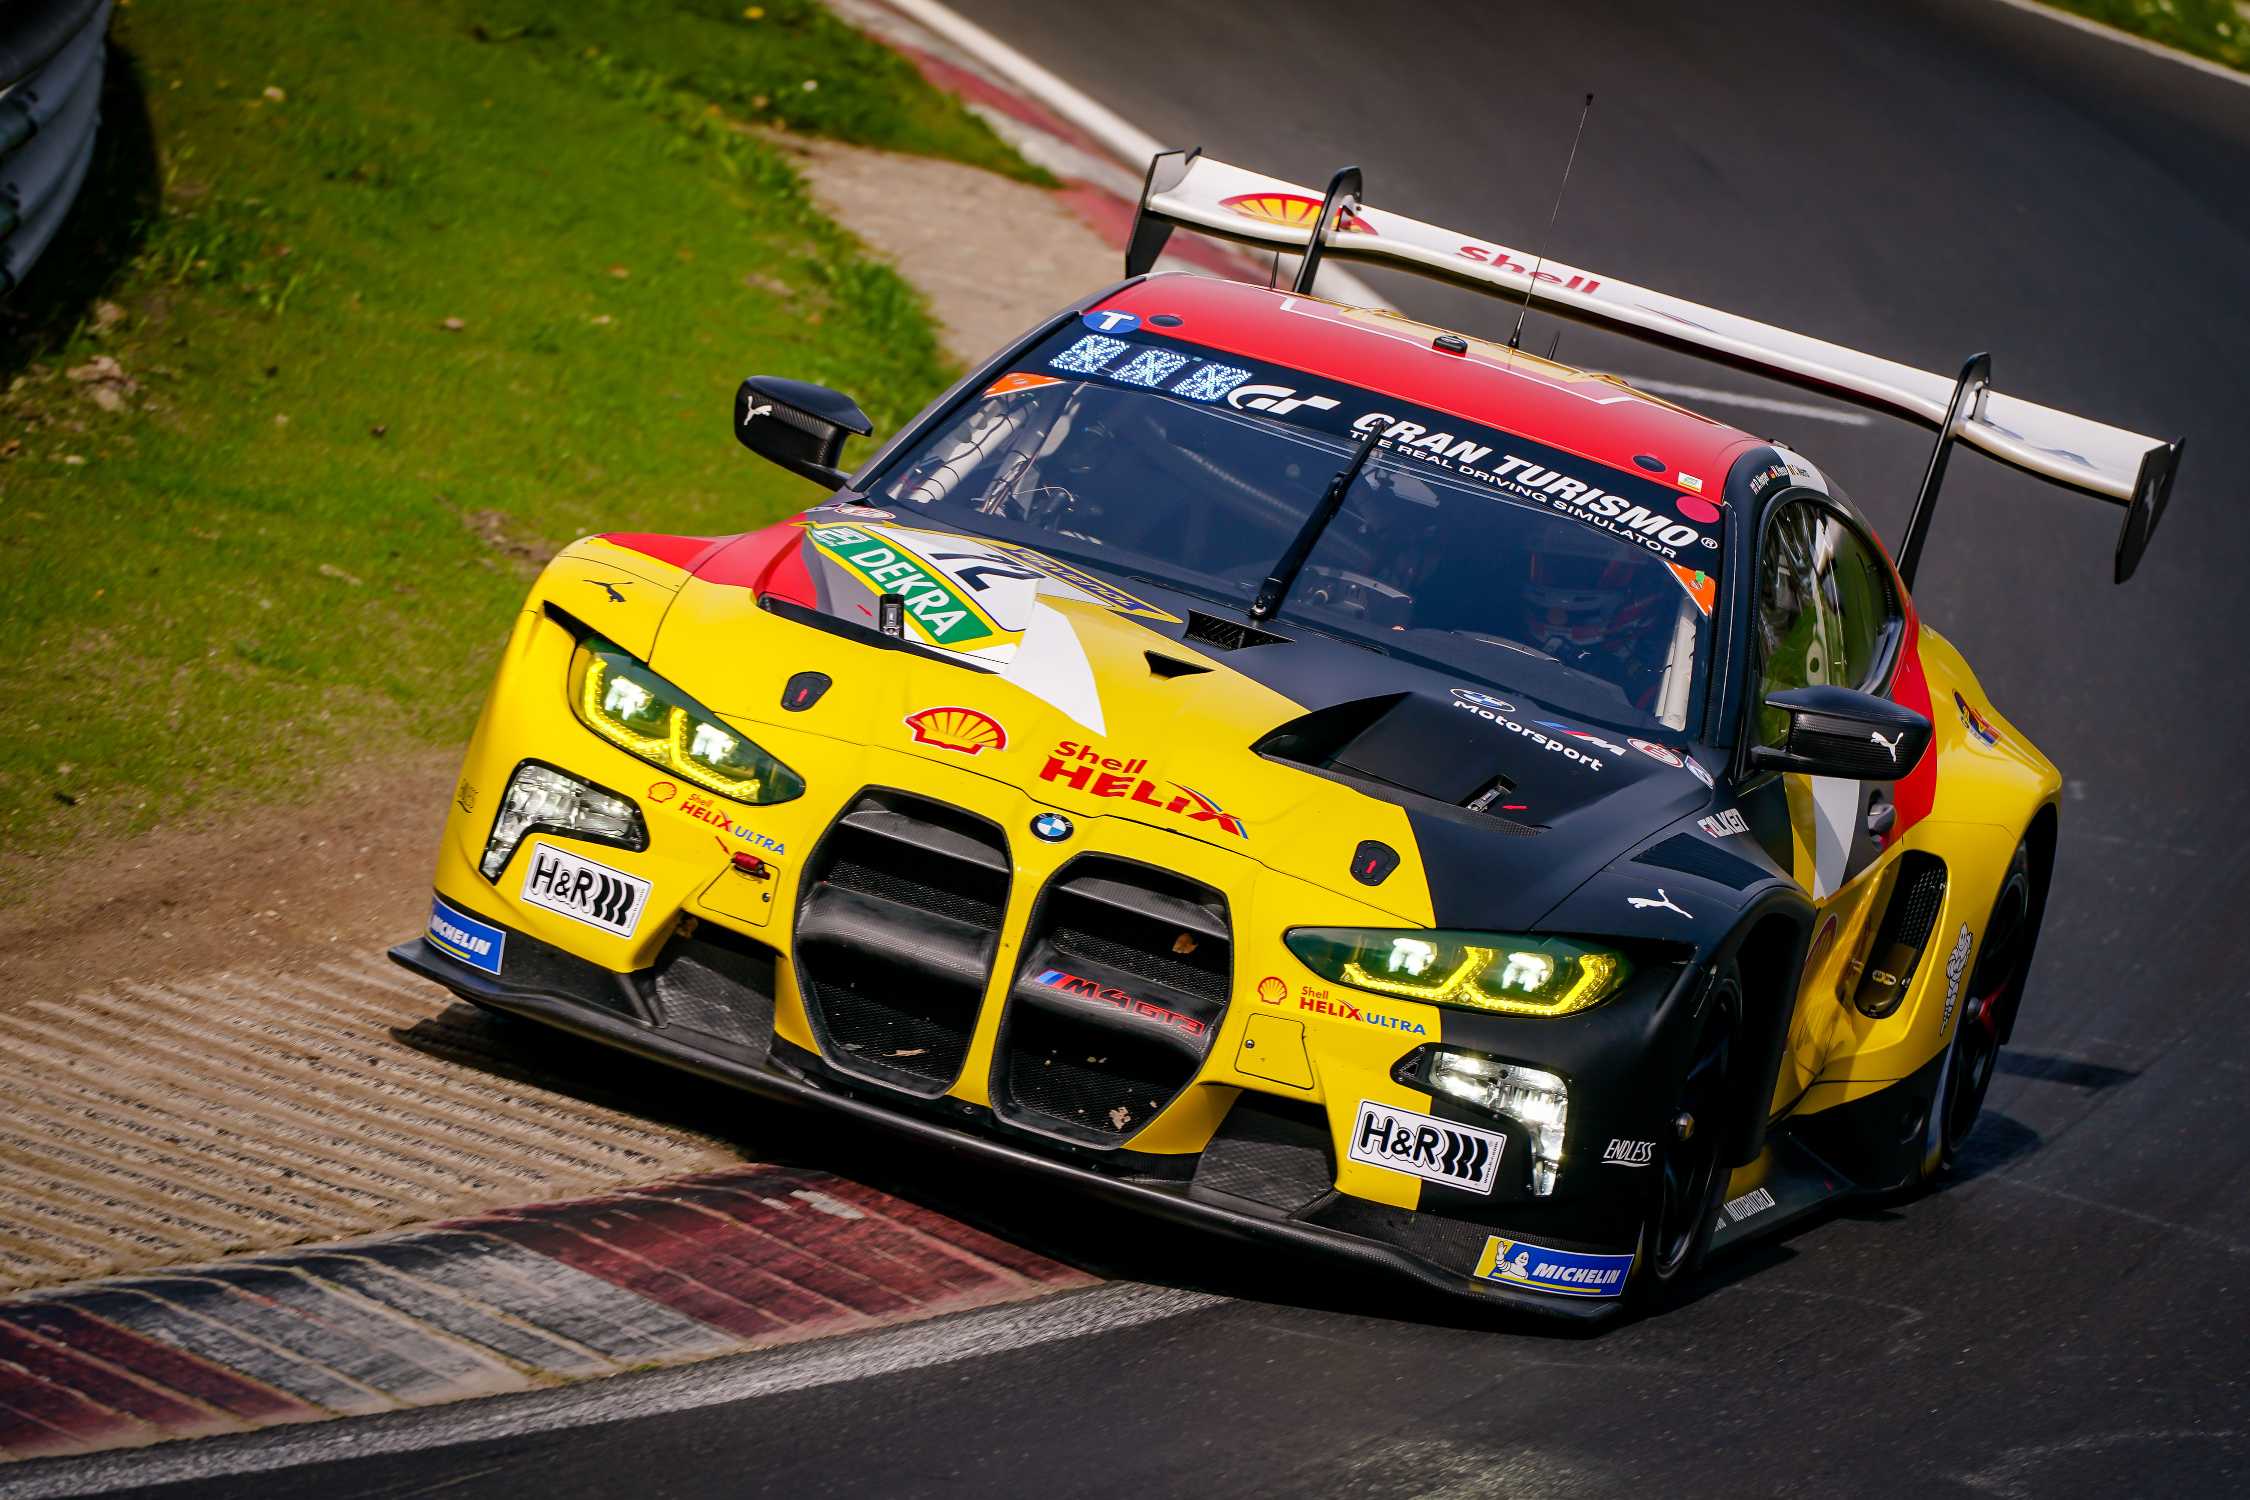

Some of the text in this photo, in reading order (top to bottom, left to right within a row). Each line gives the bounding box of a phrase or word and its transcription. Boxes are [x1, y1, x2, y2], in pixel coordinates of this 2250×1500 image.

[1456, 246, 1600, 294] Shell
[1101, 311, 1135, 331] T
[1352, 412, 1493, 464] GRAN
[1397, 445, 1453, 469] REAL
[1458, 465, 1548, 503] DRIVING
[1552, 499, 1678, 559] SIMULATOR
[848, 547, 967, 637] DEKRA
[1054, 740, 1148, 774] Shell
[1453, 700, 1603, 772] Motorsport
[1039, 755, 1249, 840] HELIX
[680, 801, 785, 855] HELIX ULTRA
[531, 854, 594, 908] H&R
[1300, 997, 1427, 1035] HELIX ULTRA
[1301, 986, 1329, 1000] Shell
[1360, 1113, 1440, 1166] H&R
[1603, 1139, 1656, 1162] ENDLESS
[1532, 1262, 1622, 1284] MICHELIN
